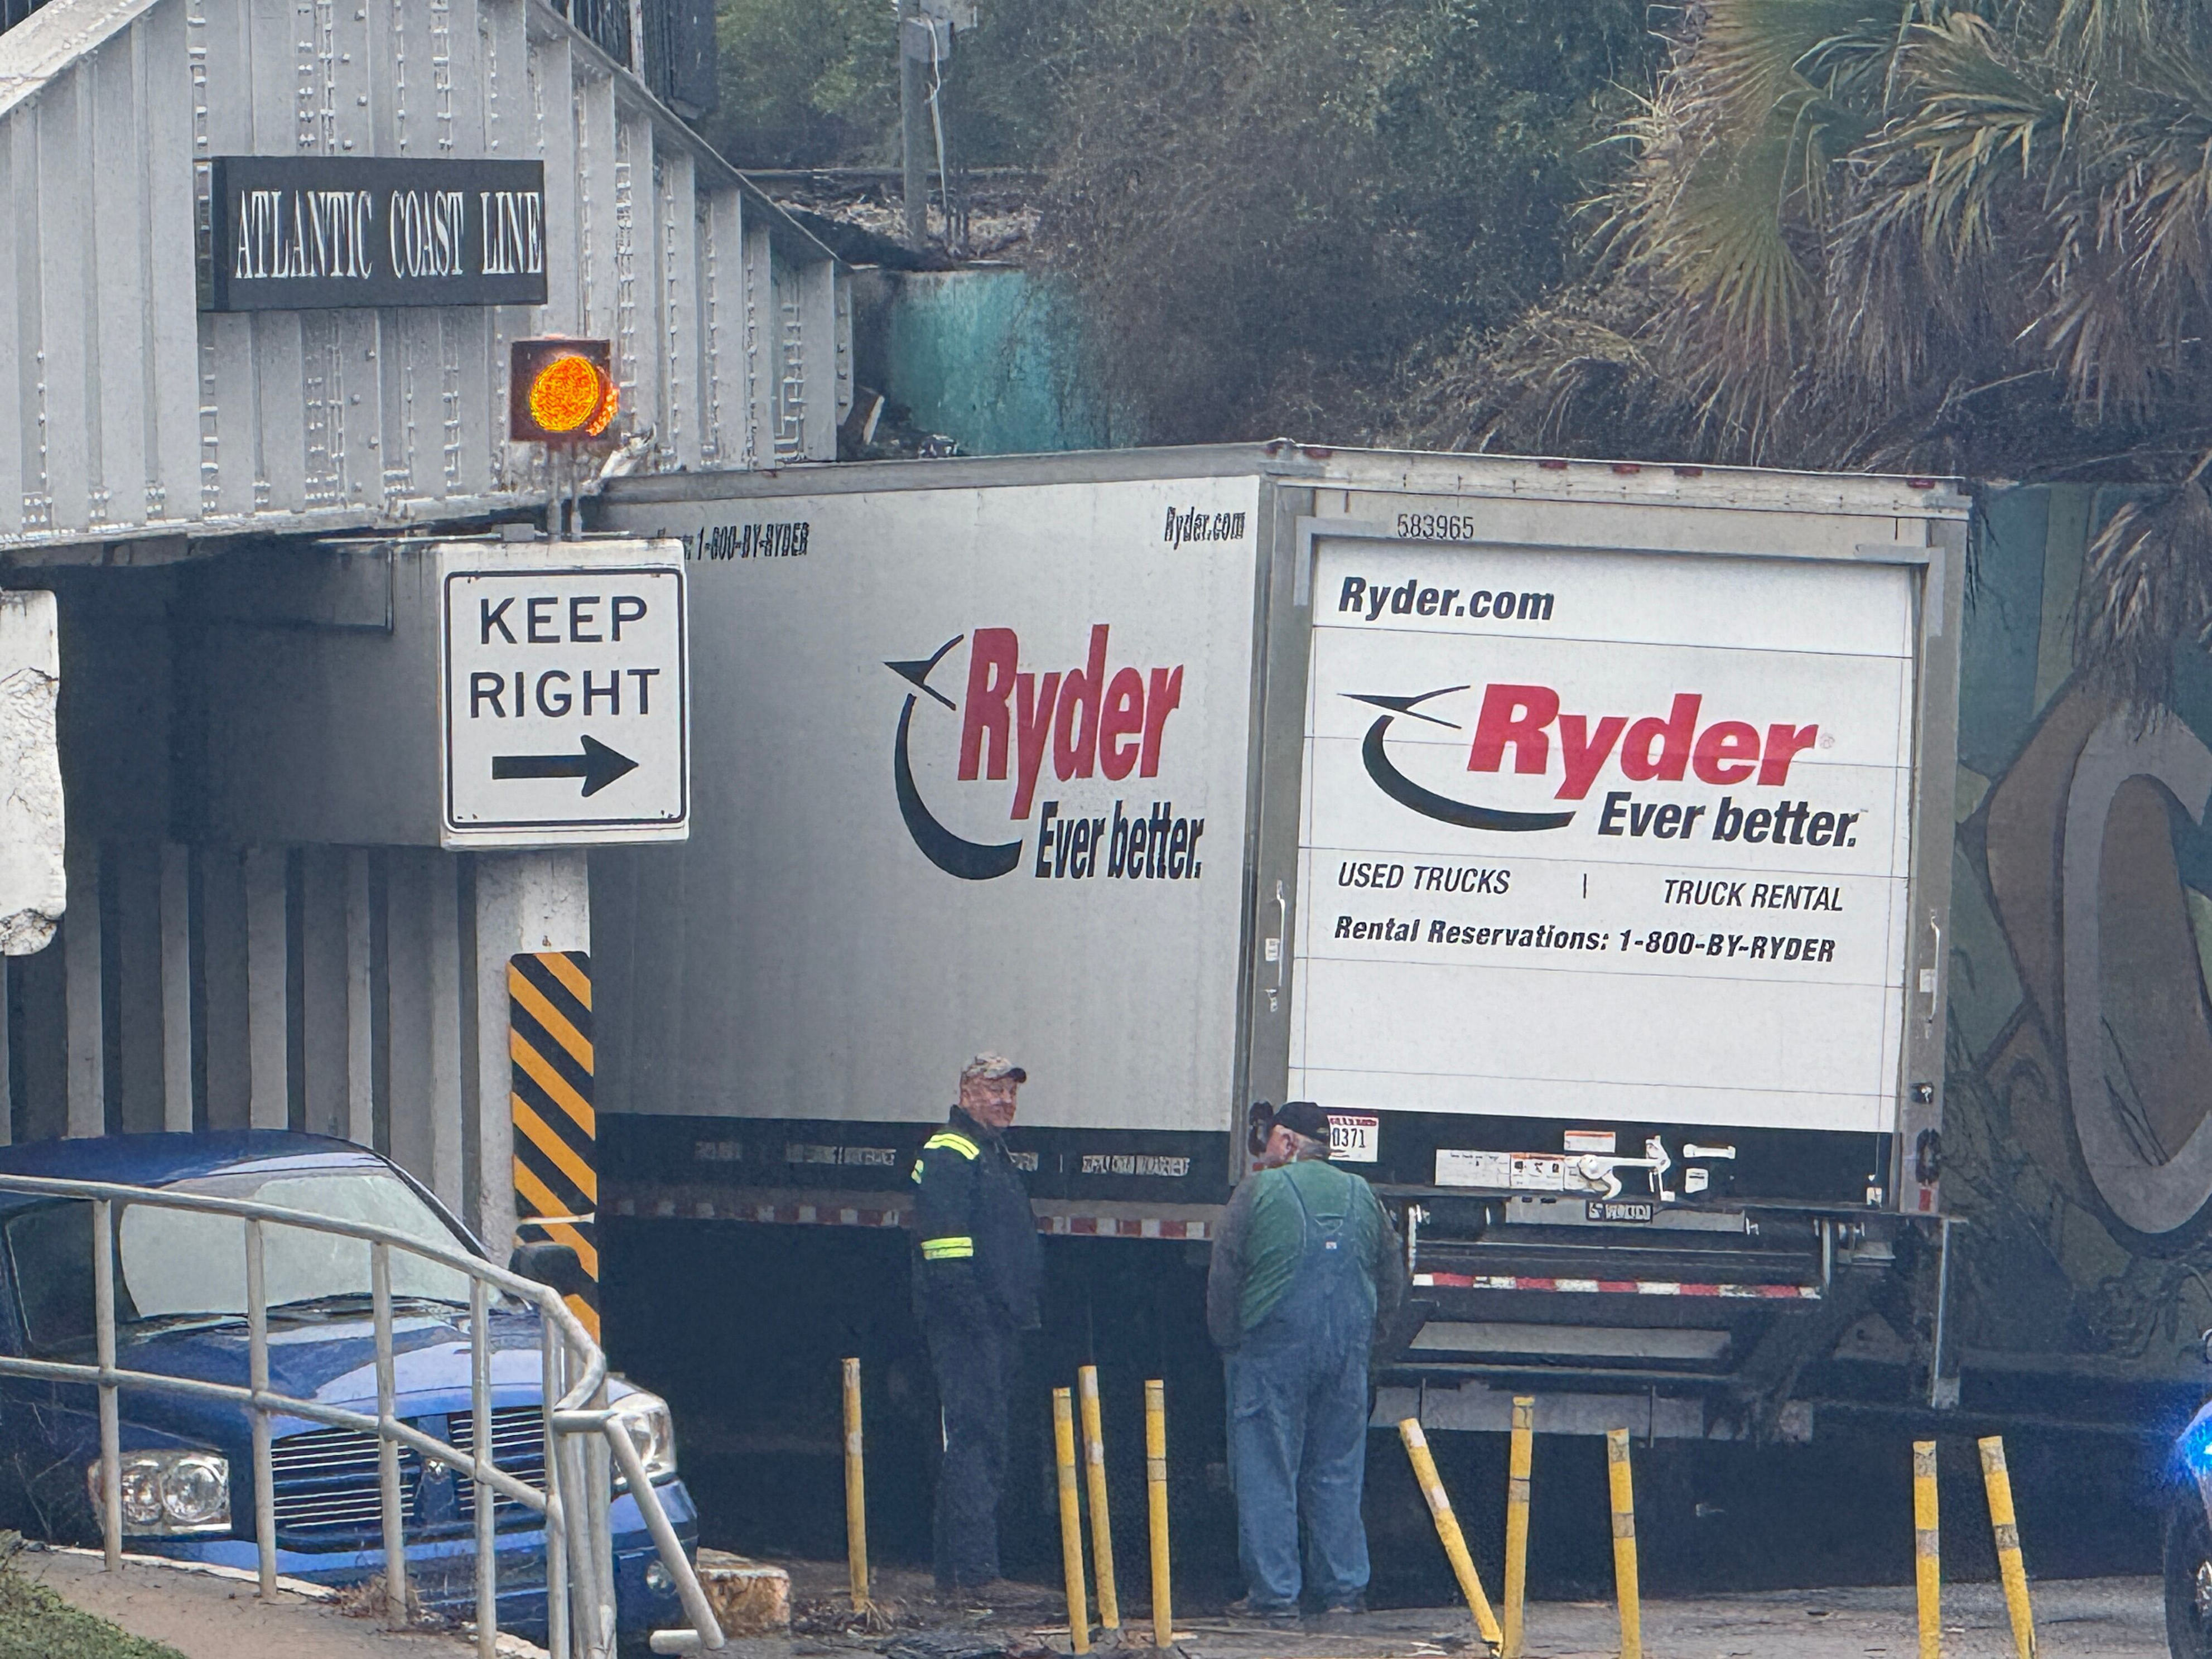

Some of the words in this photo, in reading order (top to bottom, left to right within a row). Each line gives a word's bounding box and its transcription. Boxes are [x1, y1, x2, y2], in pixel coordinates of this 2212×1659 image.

[235, 191, 372, 279] ATLANTIC
[391, 190, 464, 278] COAST
[480, 191, 542, 275] LINE
[1164, 506, 1245, 550] Ryder.com
[1397, 513, 1474, 539] 583965
[481, 596, 647, 644] KEEP
[1339, 576, 1554, 621] Ryder.com
[470, 668, 660, 718] RIGHT
[957, 624, 1184, 820] Ryder
[1467, 684, 1818, 799] Ryder
[1035, 801, 1106, 879] Ever
[1107, 800, 1204, 879] better.
[1598, 791, 1706, 839] Ever
[1712, 796, 1859, 847] better.
[1338, 862, 1404, 889] USED
[1413, 866, 1511, 894] TRUCKS
[1664, 879, 1743, 905] TRUCK
[1751, 884, 1843, 912] RENTAL
[1334, 916, 1419, 942] Rental
[1428, 920, 1610, 951] Reservations:
[1619, 929, 1836, 962] 1-800-BY-RYDER
